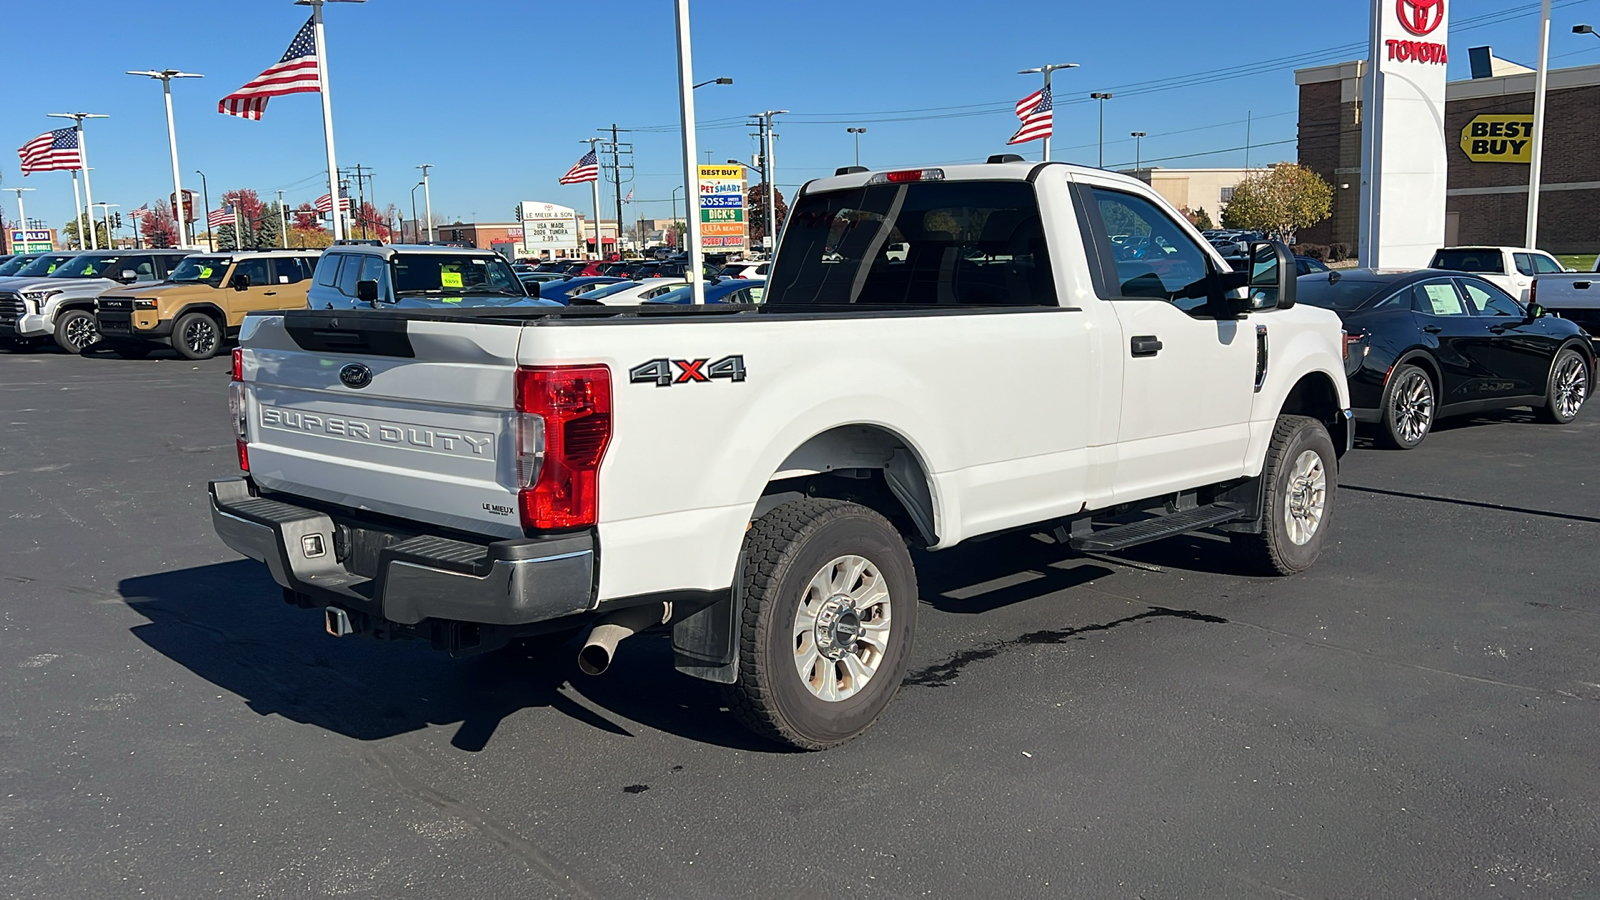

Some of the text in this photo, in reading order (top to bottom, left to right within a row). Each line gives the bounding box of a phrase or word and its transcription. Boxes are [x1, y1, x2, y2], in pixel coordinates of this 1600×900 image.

[1385, 39, 1448, 66] TOYOTA
[1471, 122, 1534, 138] BEST
[1471, 140, 1529, 155] BUY
[709, 209, 736, 219] DICK'S
[704, 224, 722, 232] ULTA
[27, 232, 49, 240] ALDI
[702, 237, 743, 246] HOBBY LOBBY
[262, 407, 491, 454] SUPER DUTY
[492, 505, 514, 514] MIEUX
